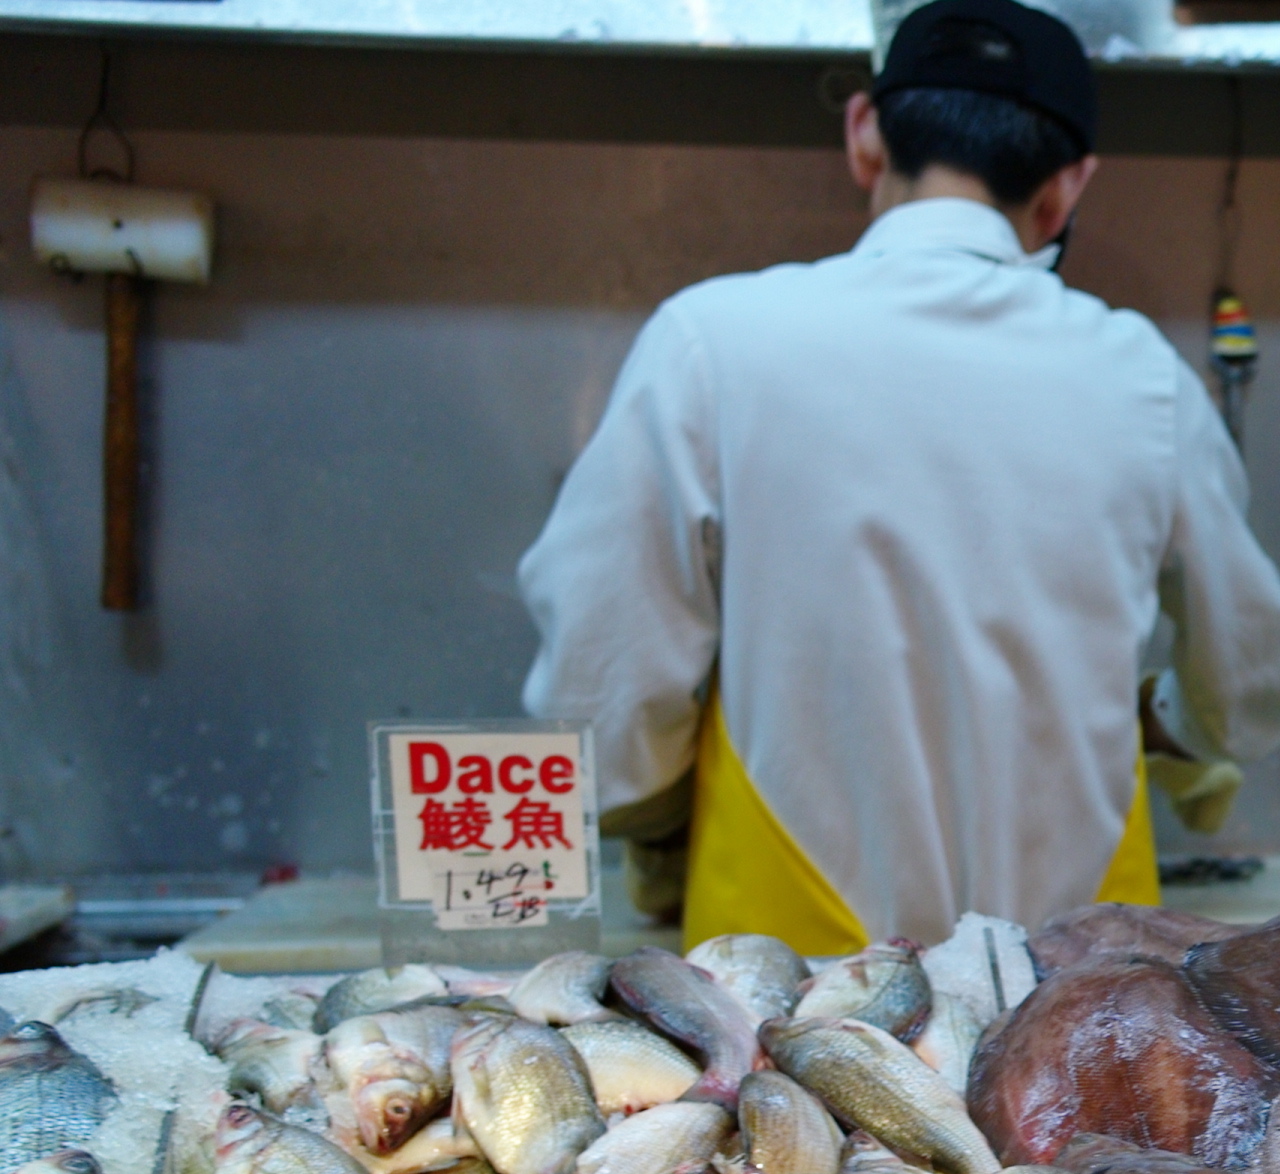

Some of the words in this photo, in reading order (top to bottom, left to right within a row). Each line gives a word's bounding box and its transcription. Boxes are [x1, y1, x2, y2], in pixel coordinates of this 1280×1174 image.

[408, 741, 575, 795] Dace
[417, 797, 574, 851] 鯪魚
[446, 862, 529, 911] 1.49
